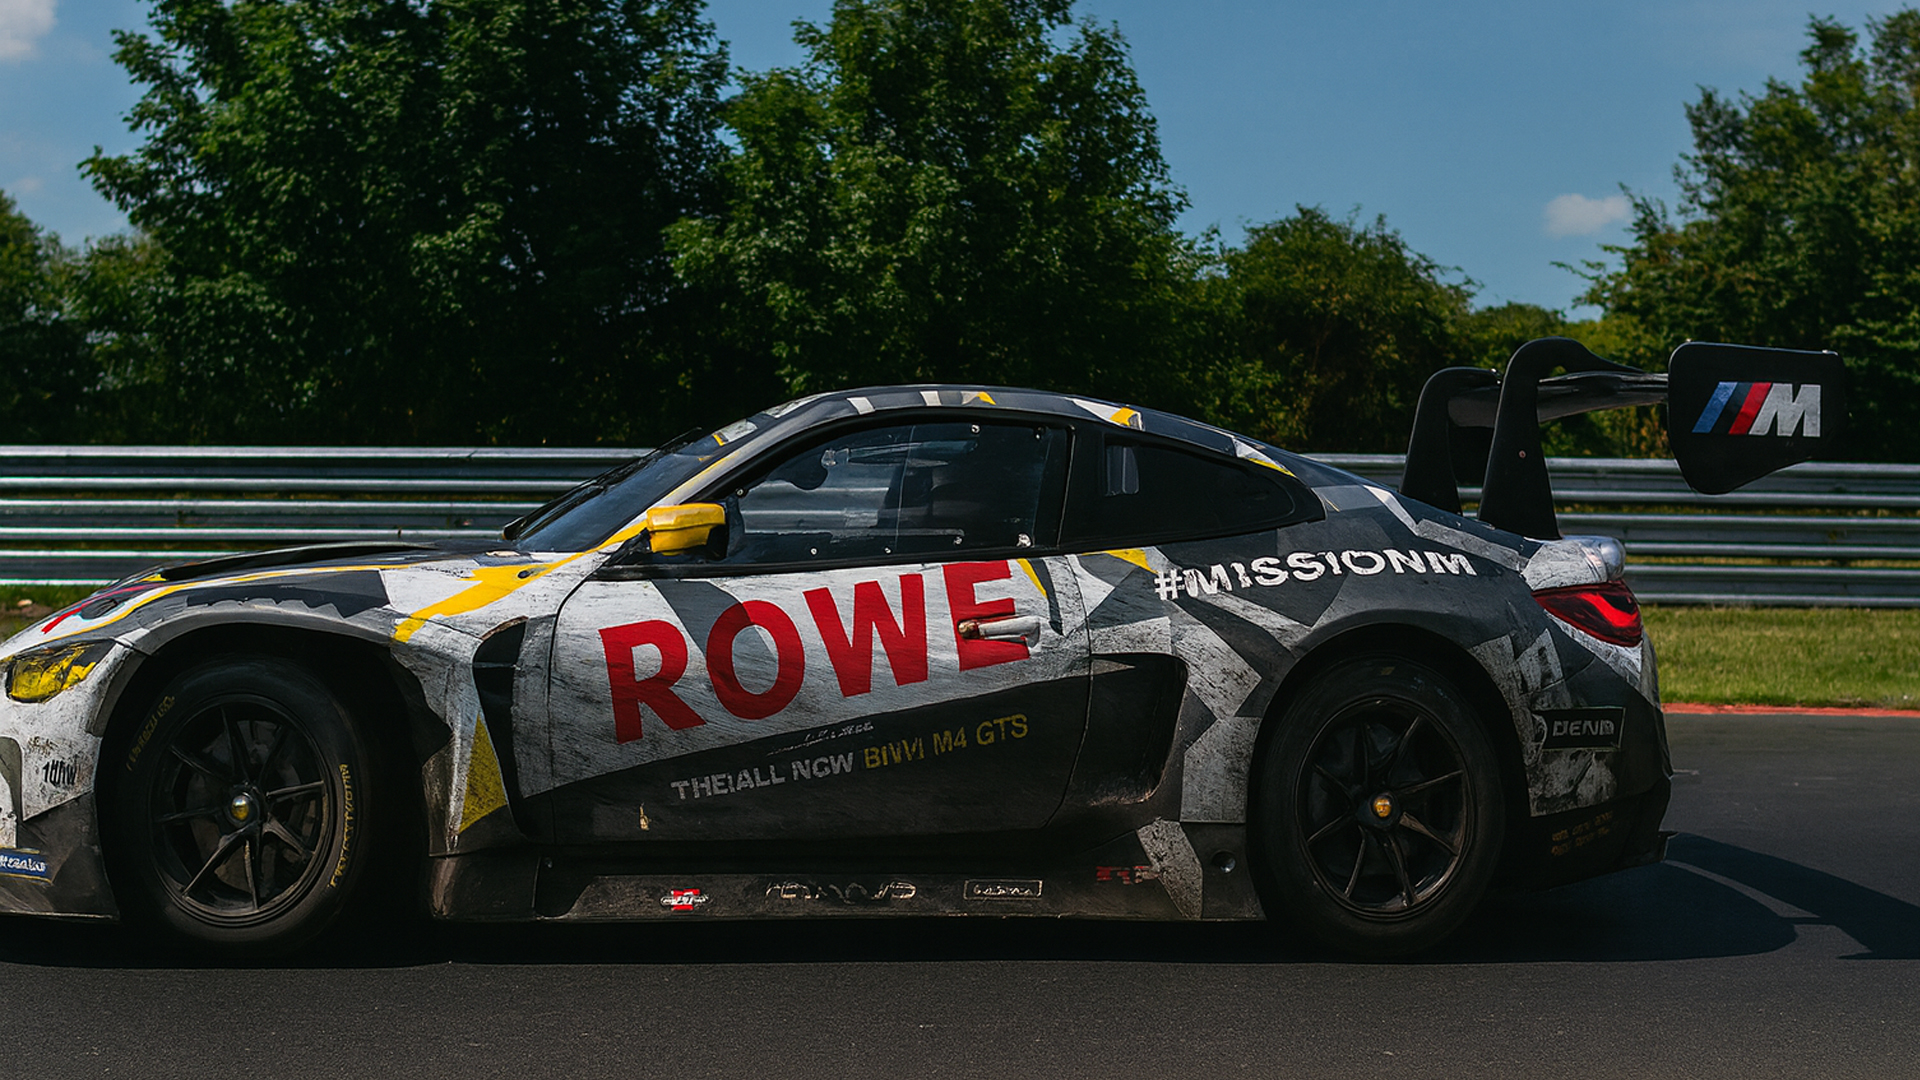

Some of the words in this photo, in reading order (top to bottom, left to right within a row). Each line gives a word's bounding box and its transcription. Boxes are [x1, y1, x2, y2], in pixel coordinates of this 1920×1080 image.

[1153, 548, 1477, 601] #MISSIONM
[598, 559, 1031, 745] ROWE
[933, 726, 968, 756] M4
[976, 713, 1029, 746] GTS
